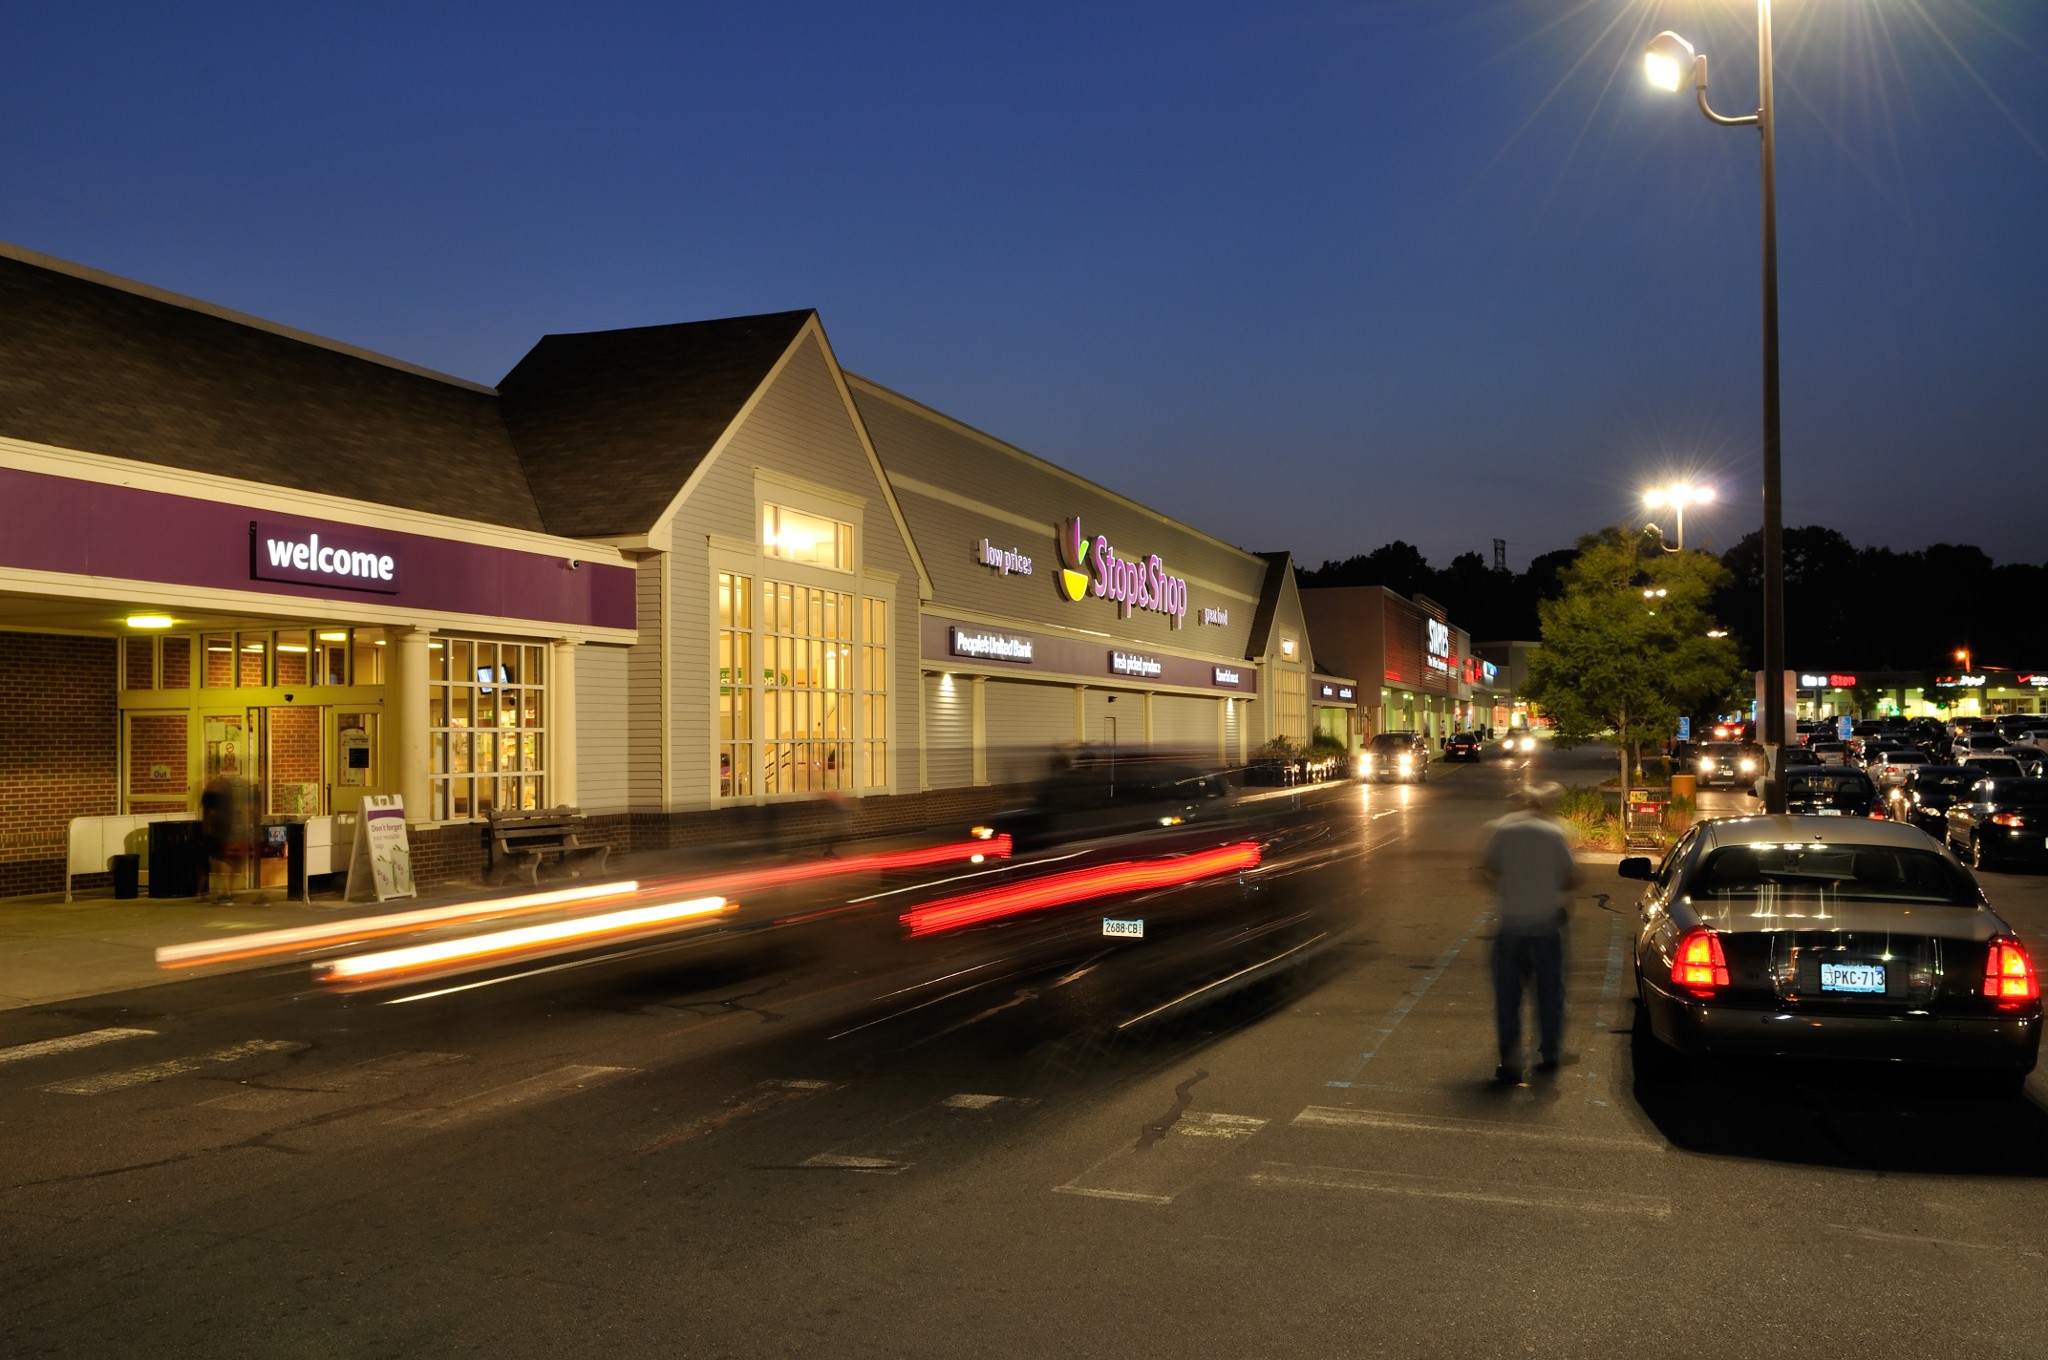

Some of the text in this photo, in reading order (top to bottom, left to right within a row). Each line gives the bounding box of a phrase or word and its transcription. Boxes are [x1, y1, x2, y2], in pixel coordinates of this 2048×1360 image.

[266, 533, 394, 581] welcome
[984, 538, 1033, 576] low prices
[990, 636, 1013, 656] United
[1013, 639, 1032, 658] Bank
[153, 770, 168, 779] Out
[371, 823, 402, 833] Don't forget
